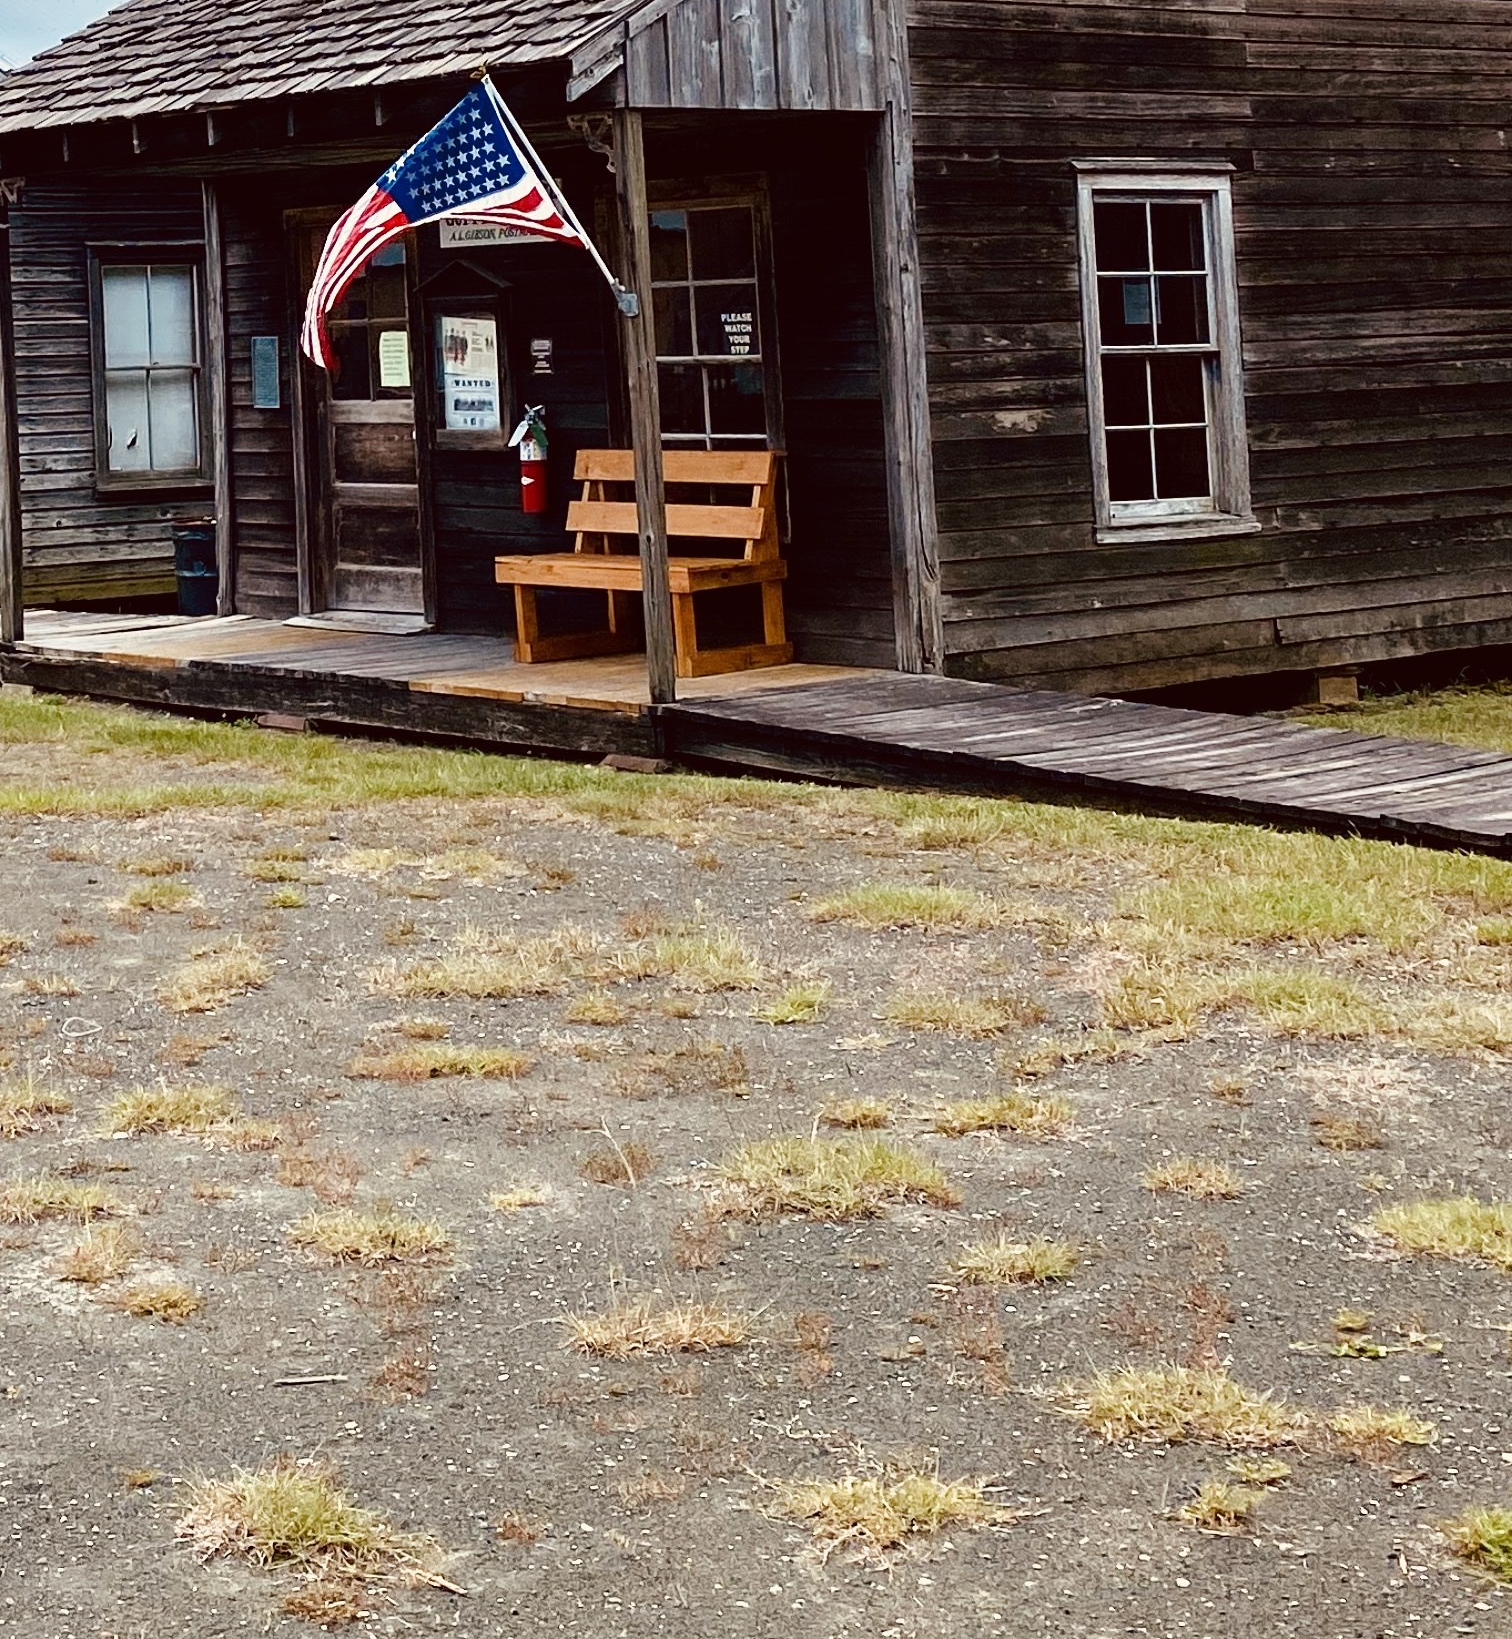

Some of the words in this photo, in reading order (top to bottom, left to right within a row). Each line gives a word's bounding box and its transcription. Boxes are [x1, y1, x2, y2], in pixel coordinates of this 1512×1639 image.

[720, 312, 753, 323] PLEASE
[723, 323, 752, 333] WATCH
[728, 335, 751, 344] YOUR
[730, 345, 750, 355] STEP
[454, 379, 491, 387] WANTED
